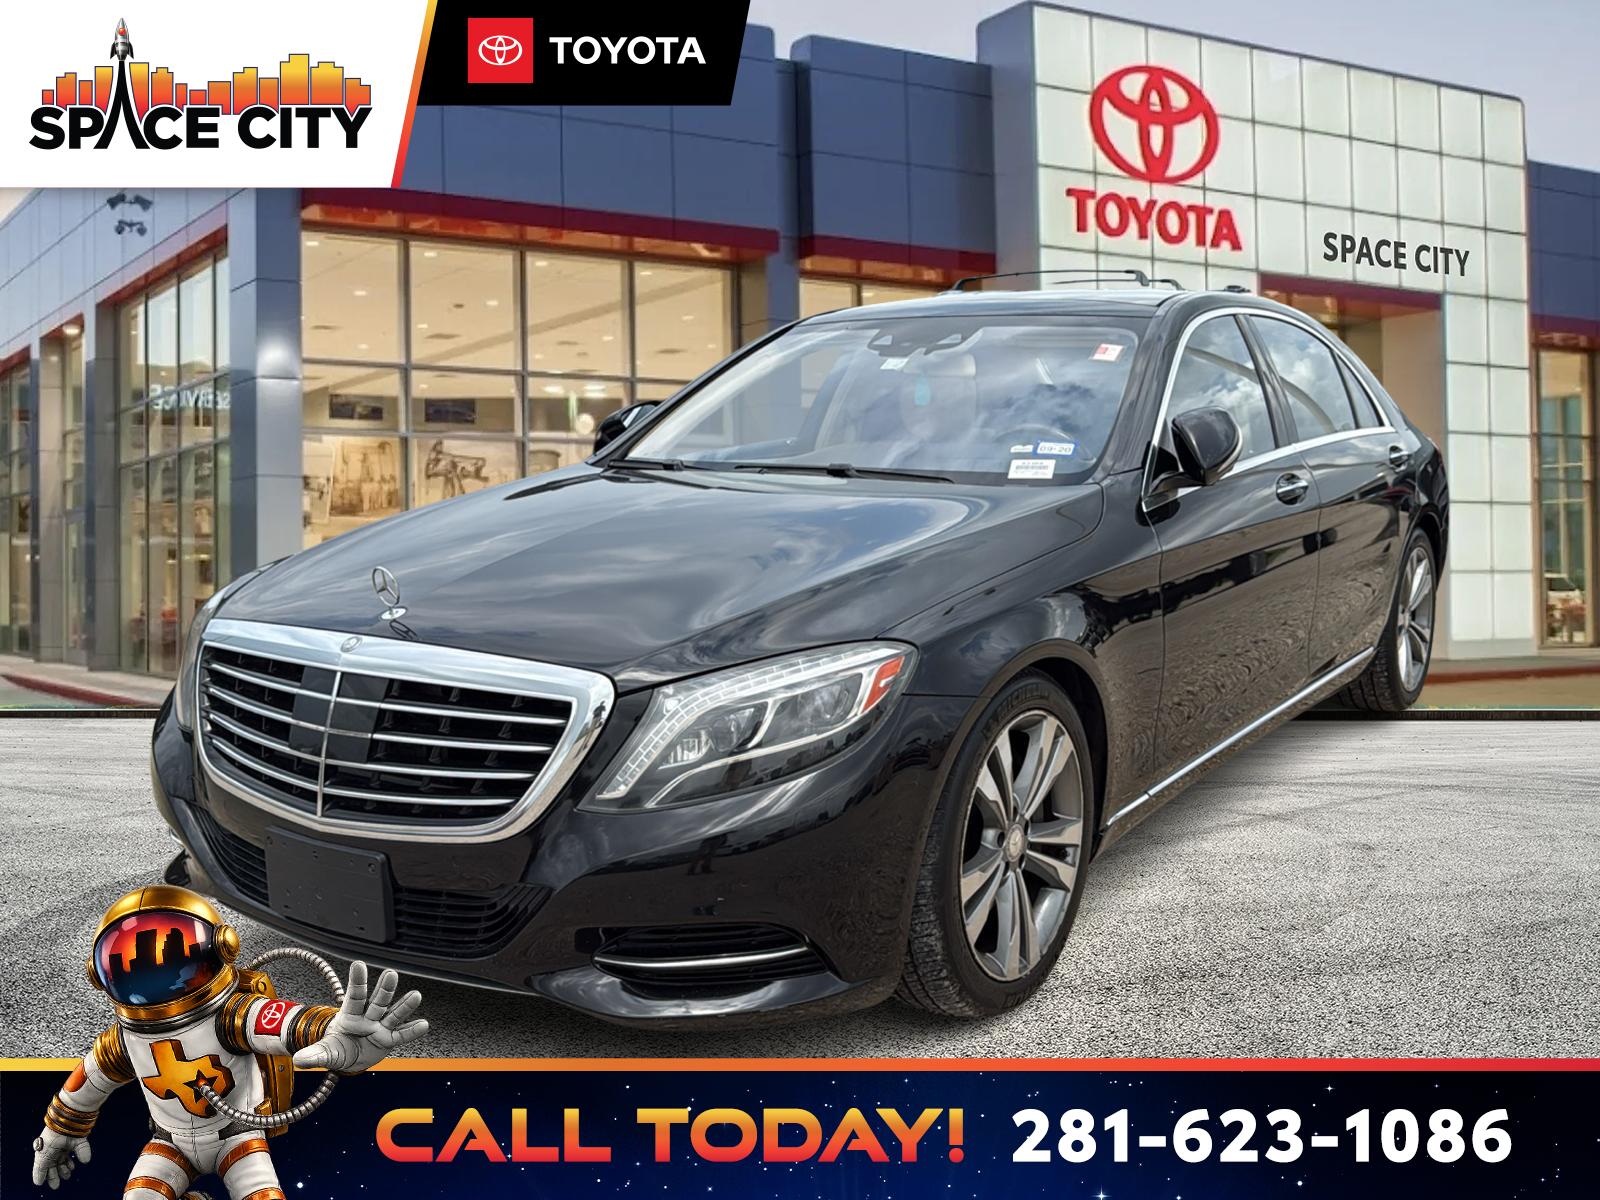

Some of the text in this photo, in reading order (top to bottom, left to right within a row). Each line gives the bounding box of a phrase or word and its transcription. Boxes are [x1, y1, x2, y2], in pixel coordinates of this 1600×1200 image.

[1066, 188, 1243, 251] TOYOTA
[1323, 232, 1470, 276] SPACE CITY
